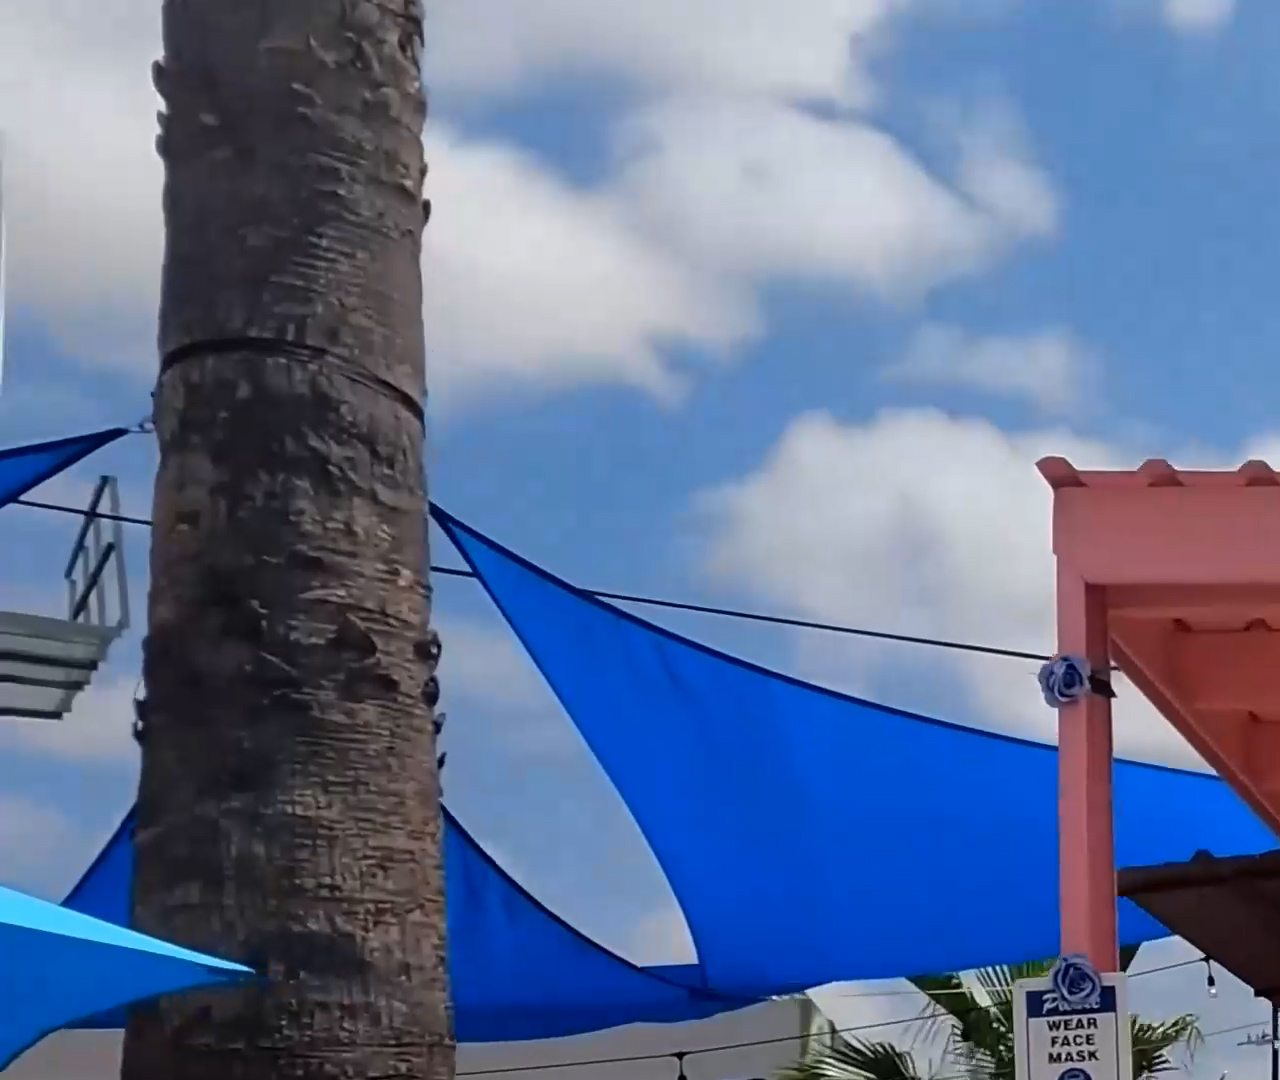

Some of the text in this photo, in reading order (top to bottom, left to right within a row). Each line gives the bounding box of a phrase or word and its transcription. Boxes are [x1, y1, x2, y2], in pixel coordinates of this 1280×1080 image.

[1047, 1017, 1099, 1032] WEAR
[1051, 1033, 1096, 1048] FACE
[1048, 1050, 1100, 1064] MASK
